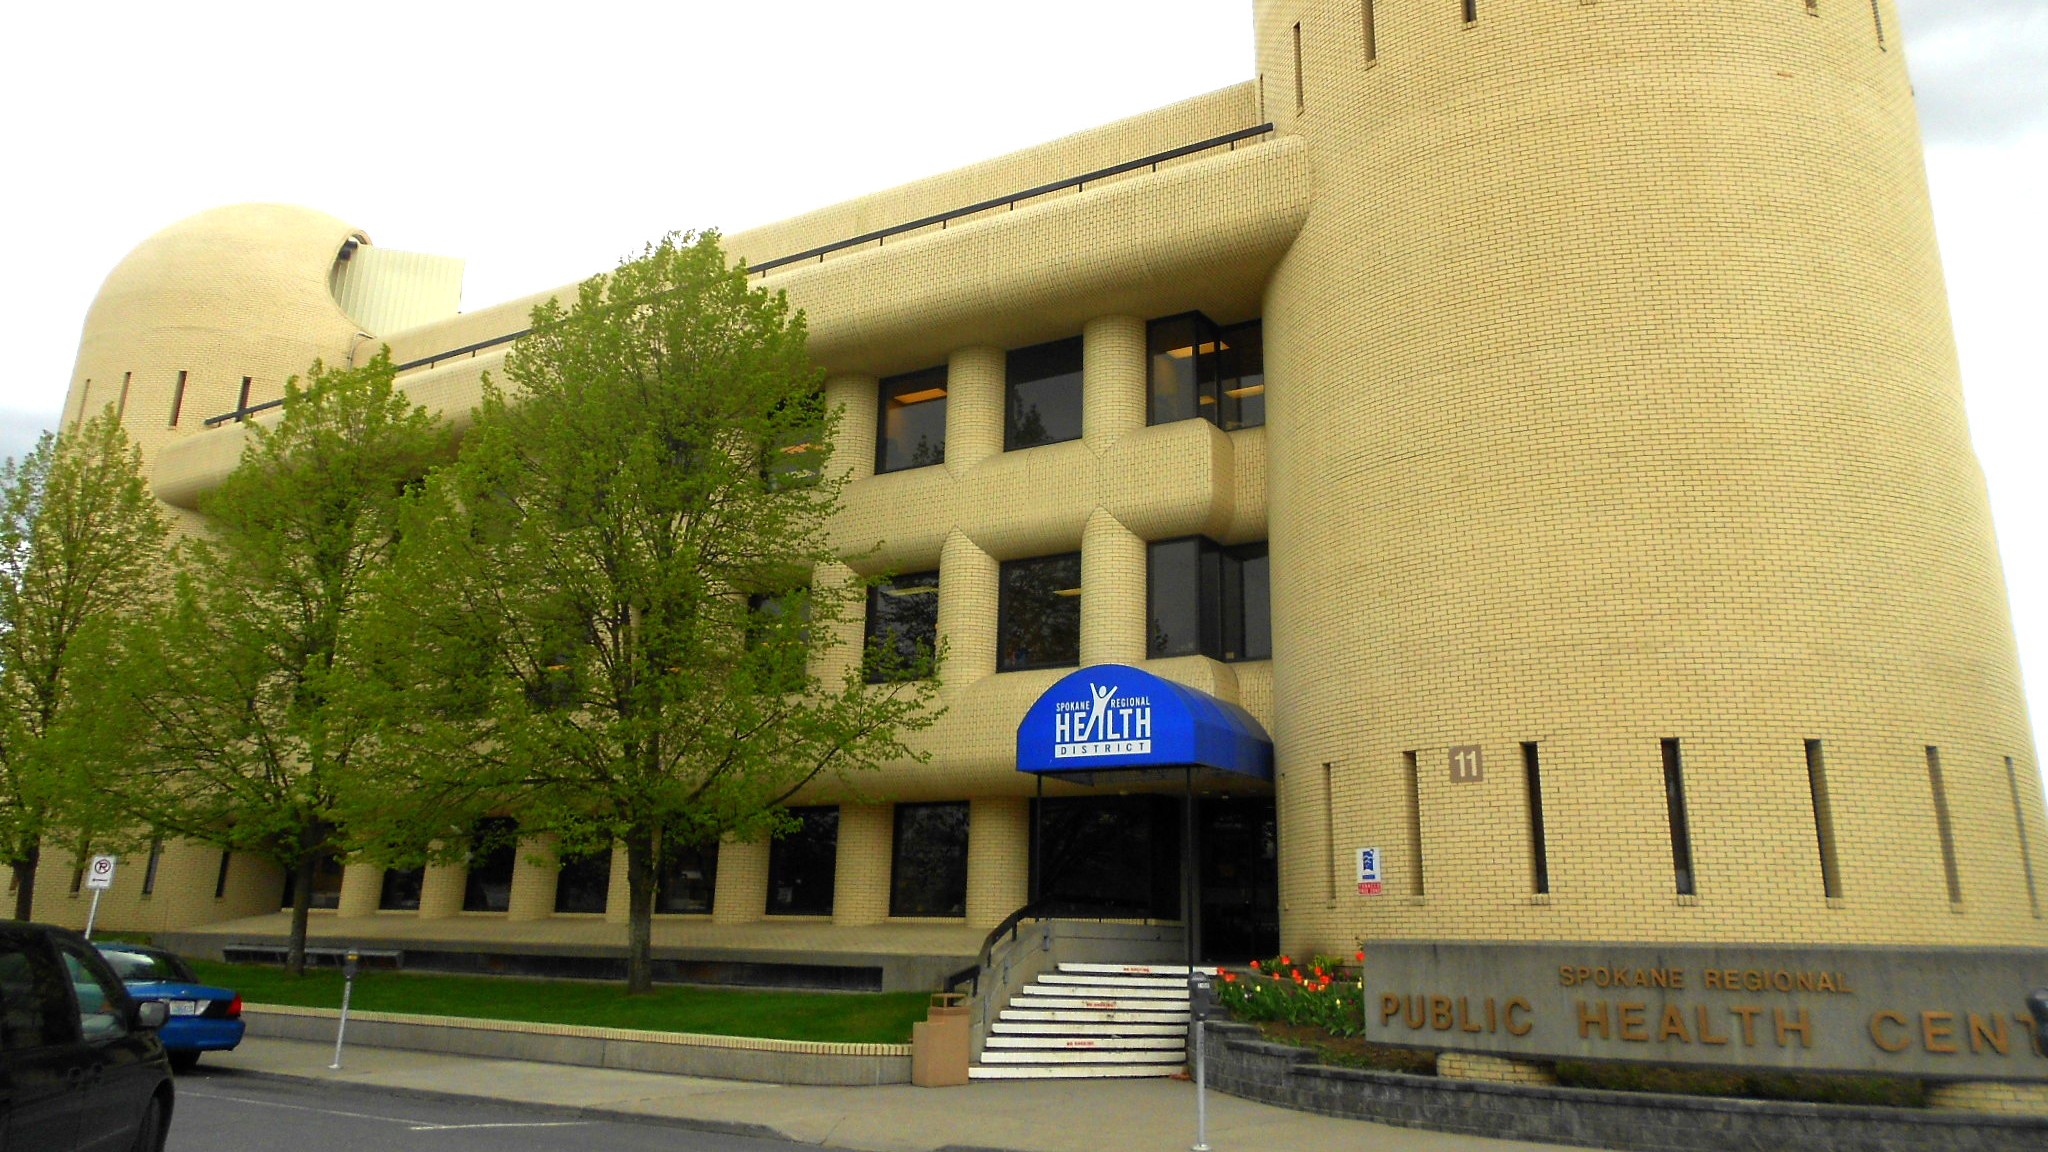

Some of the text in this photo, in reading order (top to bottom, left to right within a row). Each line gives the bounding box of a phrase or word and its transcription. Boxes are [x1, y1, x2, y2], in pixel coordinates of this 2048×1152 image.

[1056, 696, 1150, 712] SPOKANE REGIONAL
[1055, 693, 1151, 743] HEALTH
[1060, 742, 1145, 755] DISTRICT
[1454, 750, 1477, 777] 11
[1558, 965, 1853, 993] SPOKANE REGIONAL
[1380, 992, 1533, 1036] PUBLIC
[1577, 1000, 1813, 1048] HEALTH
